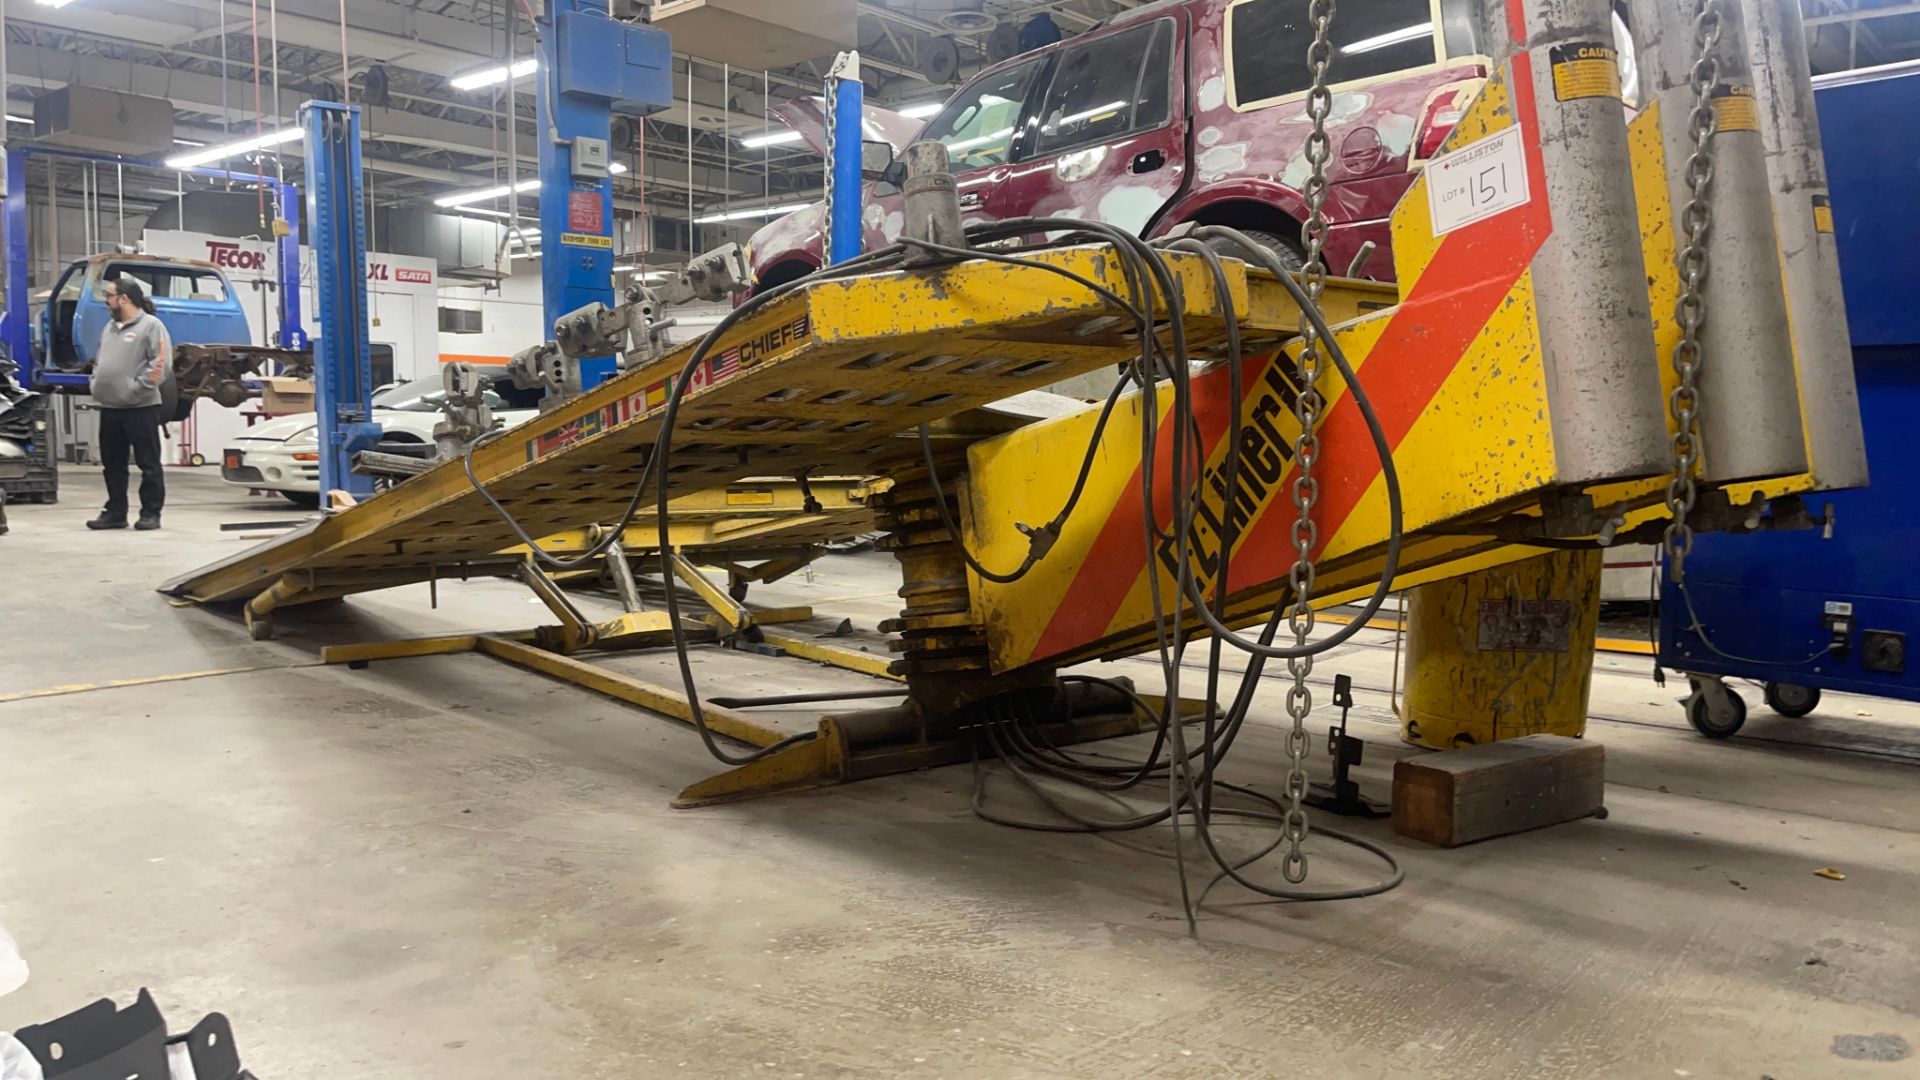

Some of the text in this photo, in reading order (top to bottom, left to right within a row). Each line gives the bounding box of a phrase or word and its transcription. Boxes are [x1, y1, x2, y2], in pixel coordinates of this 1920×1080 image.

[1452, 138, 1504, 168] WILLISTON
[1442, 188, 1458, 203] LOT
[1469, 162, 1507, 207] 151
[206, 241, 266, 270] TECOR
[397, 270, 430, 282] SATA
[739, 323, 792, 363] CHIEF
